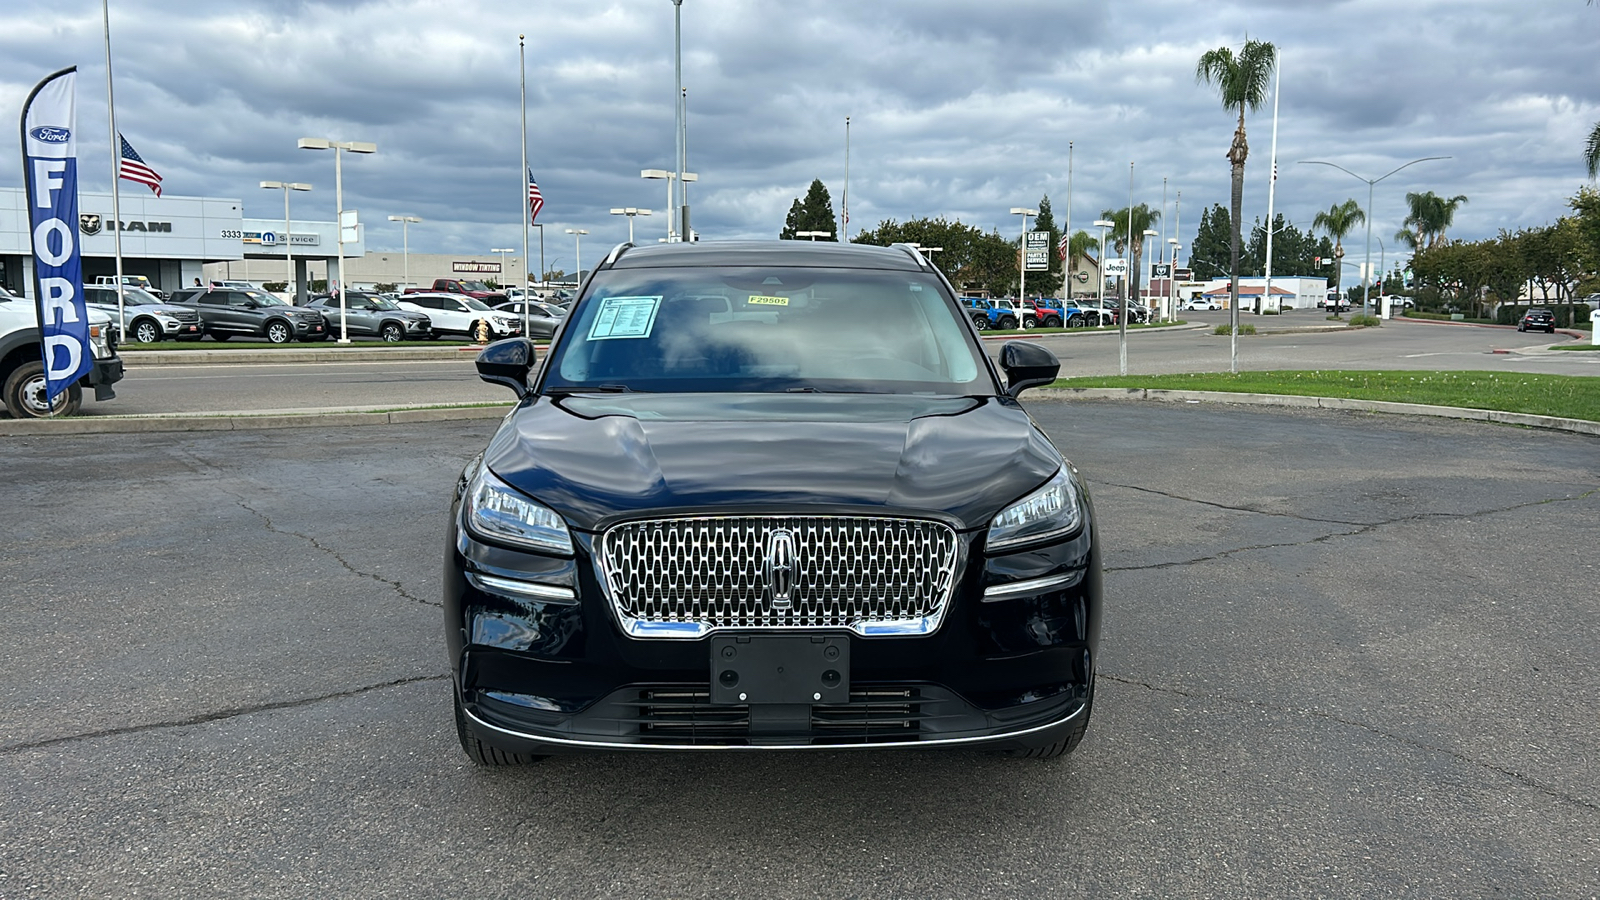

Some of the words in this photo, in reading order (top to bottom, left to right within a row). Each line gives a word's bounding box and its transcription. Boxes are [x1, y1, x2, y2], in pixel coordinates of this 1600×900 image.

[39, 128, 69, 141] Ford
[106, 220, 171, 232] RAM
[221, 230, 241, 238] 3333
[33, 159, 83, 381] FORD
[453, 263, 478, 271] WINDOW
[478, 264, 500, 272] TINTING
[1105, 264, 1126, 273] Jeep
